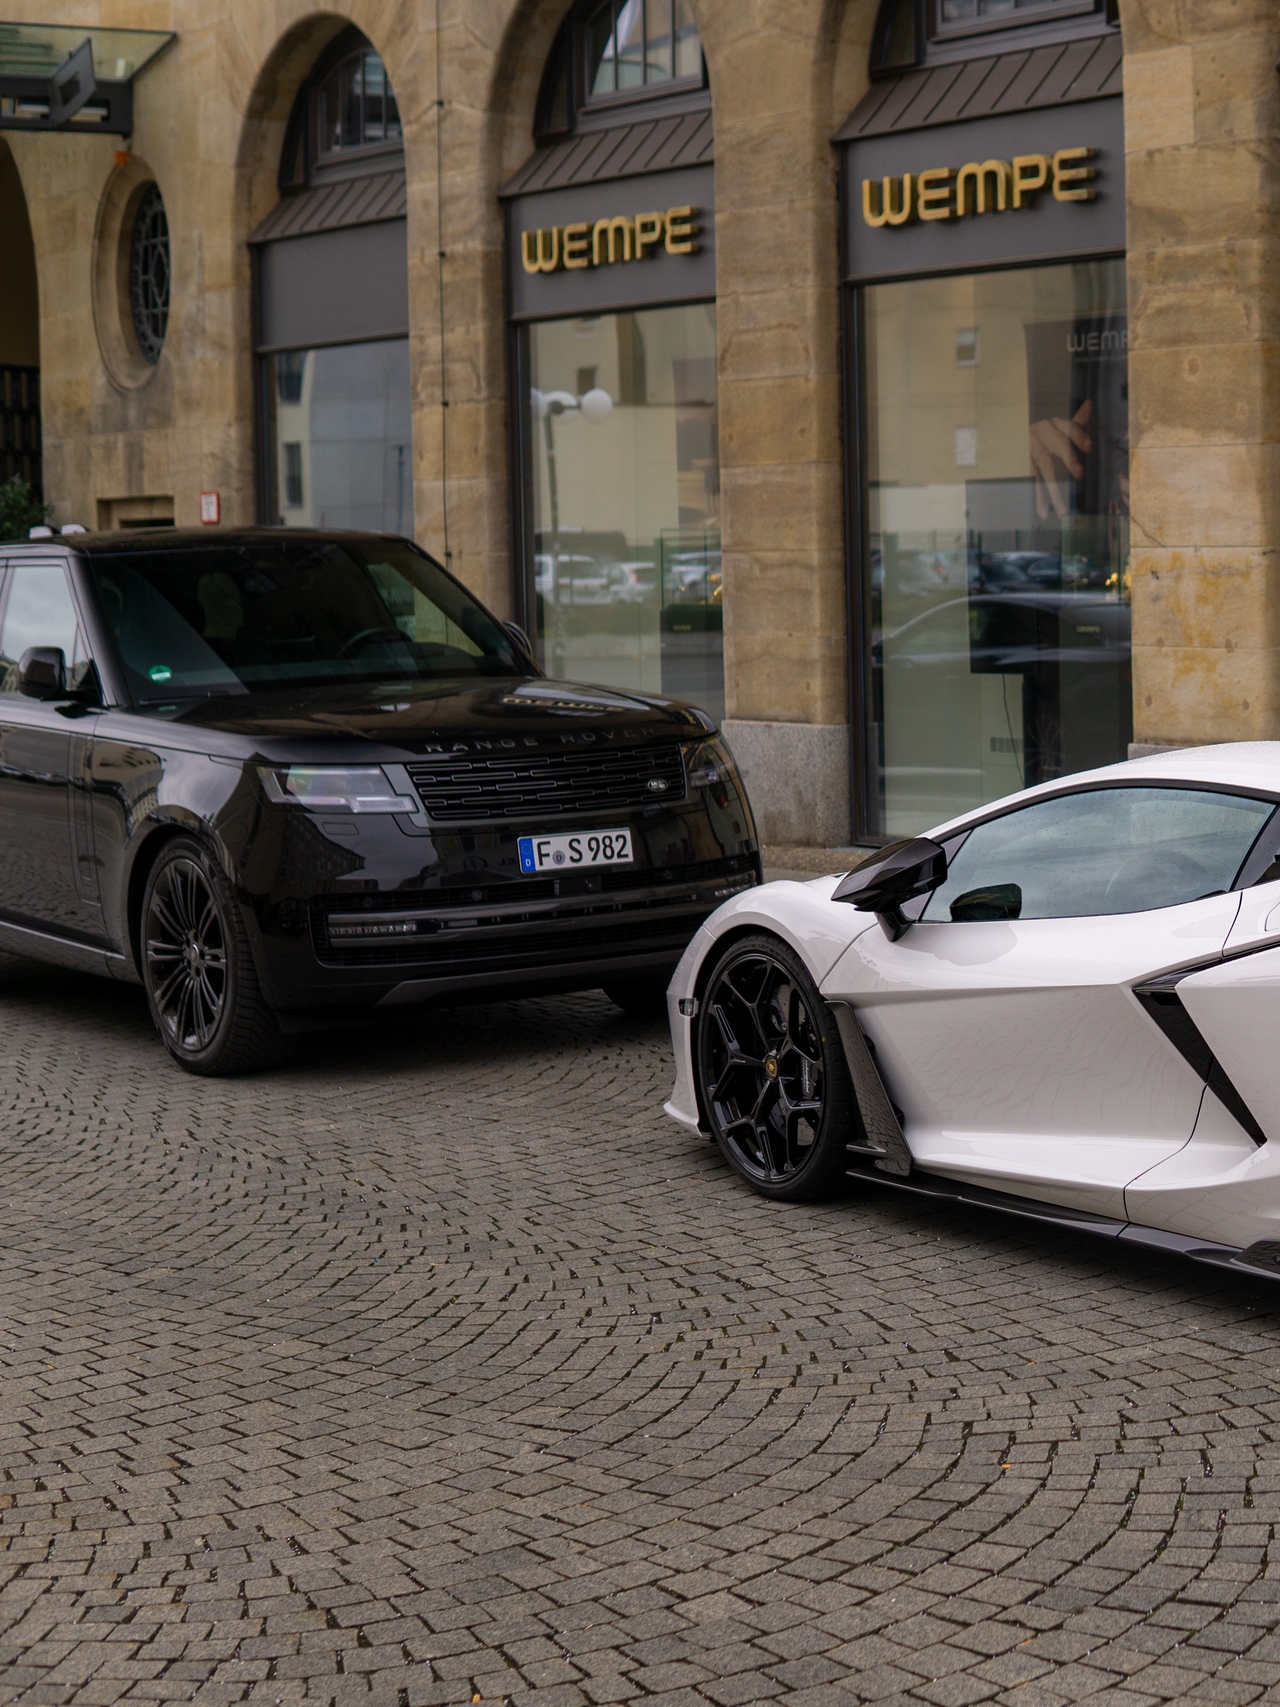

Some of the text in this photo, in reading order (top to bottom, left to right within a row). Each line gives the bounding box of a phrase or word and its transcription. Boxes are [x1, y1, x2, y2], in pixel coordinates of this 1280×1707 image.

[862, 146, 1094, 227] WEMPE
[521, 205, 697, 274] WEMPE
[425, 728, 655, 753] RANGE ROVER
[525, 859, 532, 867] D
[536, 840, 551, 867] F
